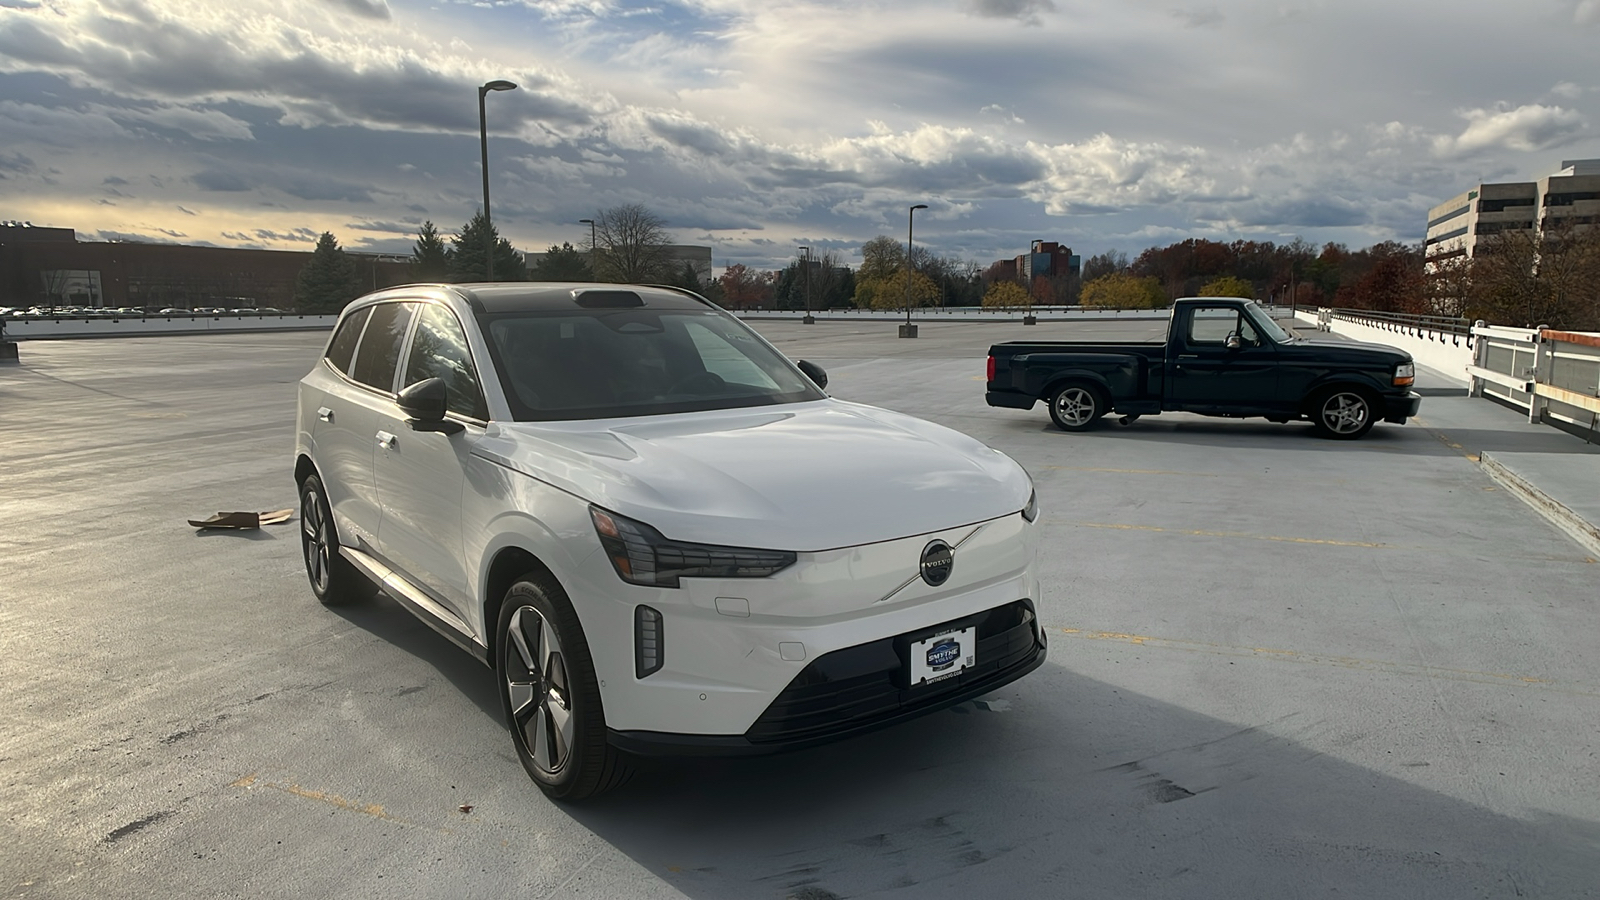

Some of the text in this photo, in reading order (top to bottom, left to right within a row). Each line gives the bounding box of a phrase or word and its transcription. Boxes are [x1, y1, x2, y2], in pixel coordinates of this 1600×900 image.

[926, 558, 951, 568] VOLVO
[928, 648, 958, 662] SMYTHE
[935, 655, 954, 664] VOLVO
